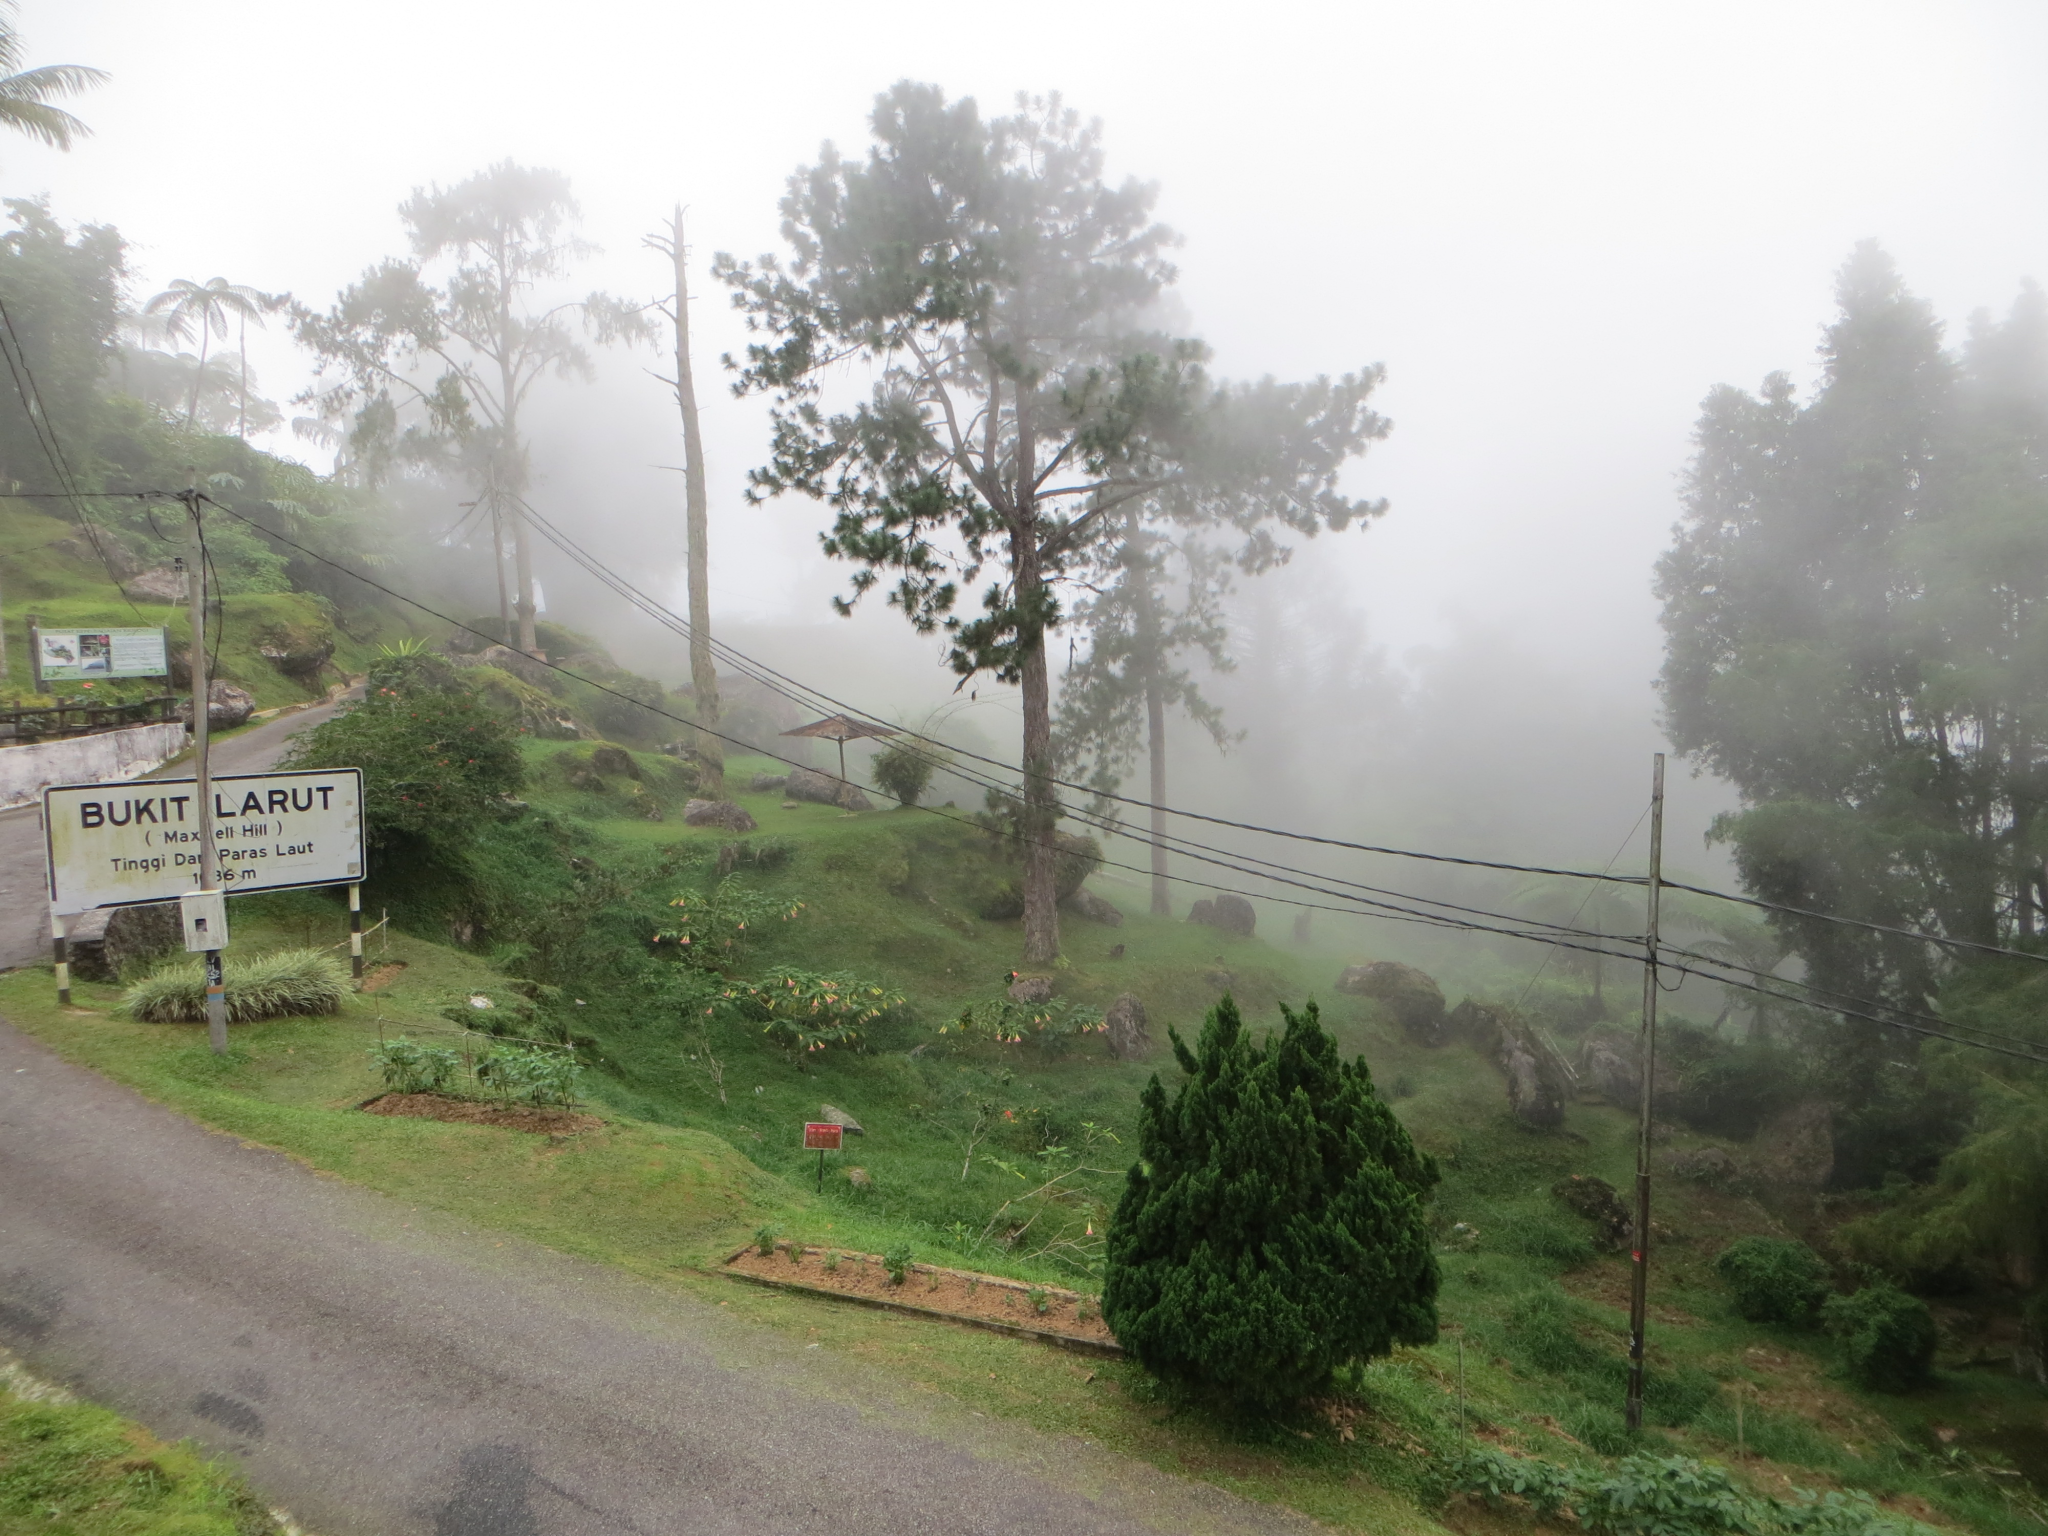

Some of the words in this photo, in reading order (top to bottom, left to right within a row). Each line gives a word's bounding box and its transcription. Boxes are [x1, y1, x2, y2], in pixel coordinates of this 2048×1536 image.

[80, 796, 190, 828] BUKIT
[215, 786, 334, 818] LARUT
[164, 826, 234, 844] Maxell
[242, 823, 268, 838] Hill
[110, 854, 166, 873] Tinggi
[219, 848, 268, 862] Paras
[276, 841, 314, 857] Laut
[193, 869, 235, 885] 136
[242, 869, 256, 880] m
